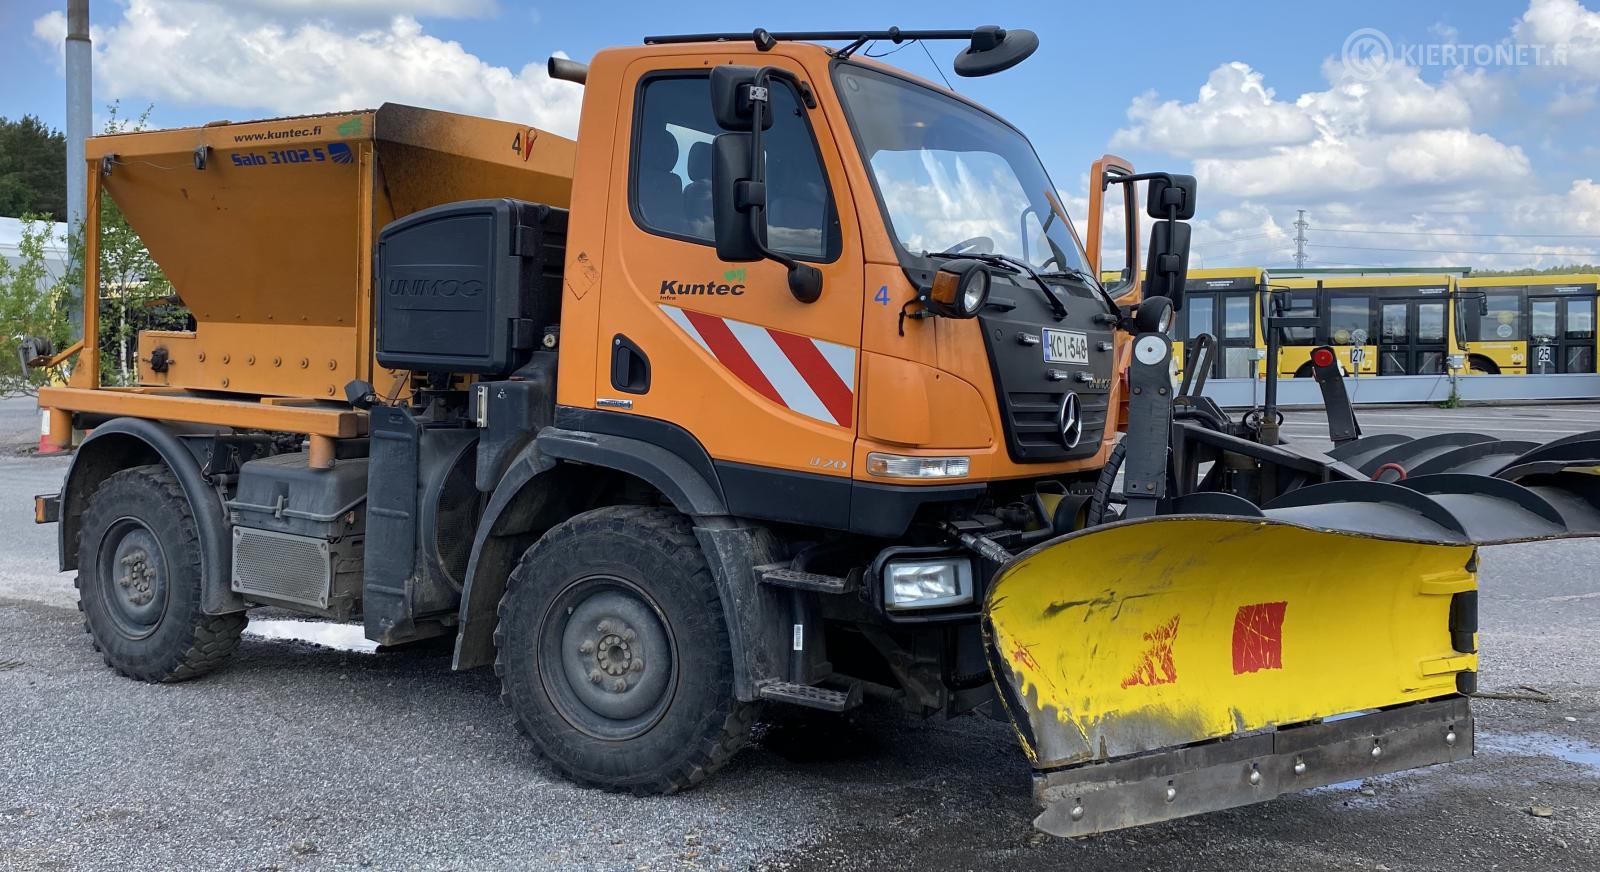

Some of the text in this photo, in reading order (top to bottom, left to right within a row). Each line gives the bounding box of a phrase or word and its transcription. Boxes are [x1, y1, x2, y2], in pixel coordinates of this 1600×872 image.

[234, 125, 322, 143] www.kuntec.fi
[511, 131, 522, 156] 4
[231, 152, 267, 167] Salo
[268, 148, 312, 165] 3102
[388, 279, 484, 298] UNIMOG
[659, 280, 746, 297] Kuntec
[874, 285, 891, 306] 4
[1050, 334, 1087, 360] KCI-548
[1352, 348, 1364, 363] 27
[1539, 348, 1550, 361] 25
